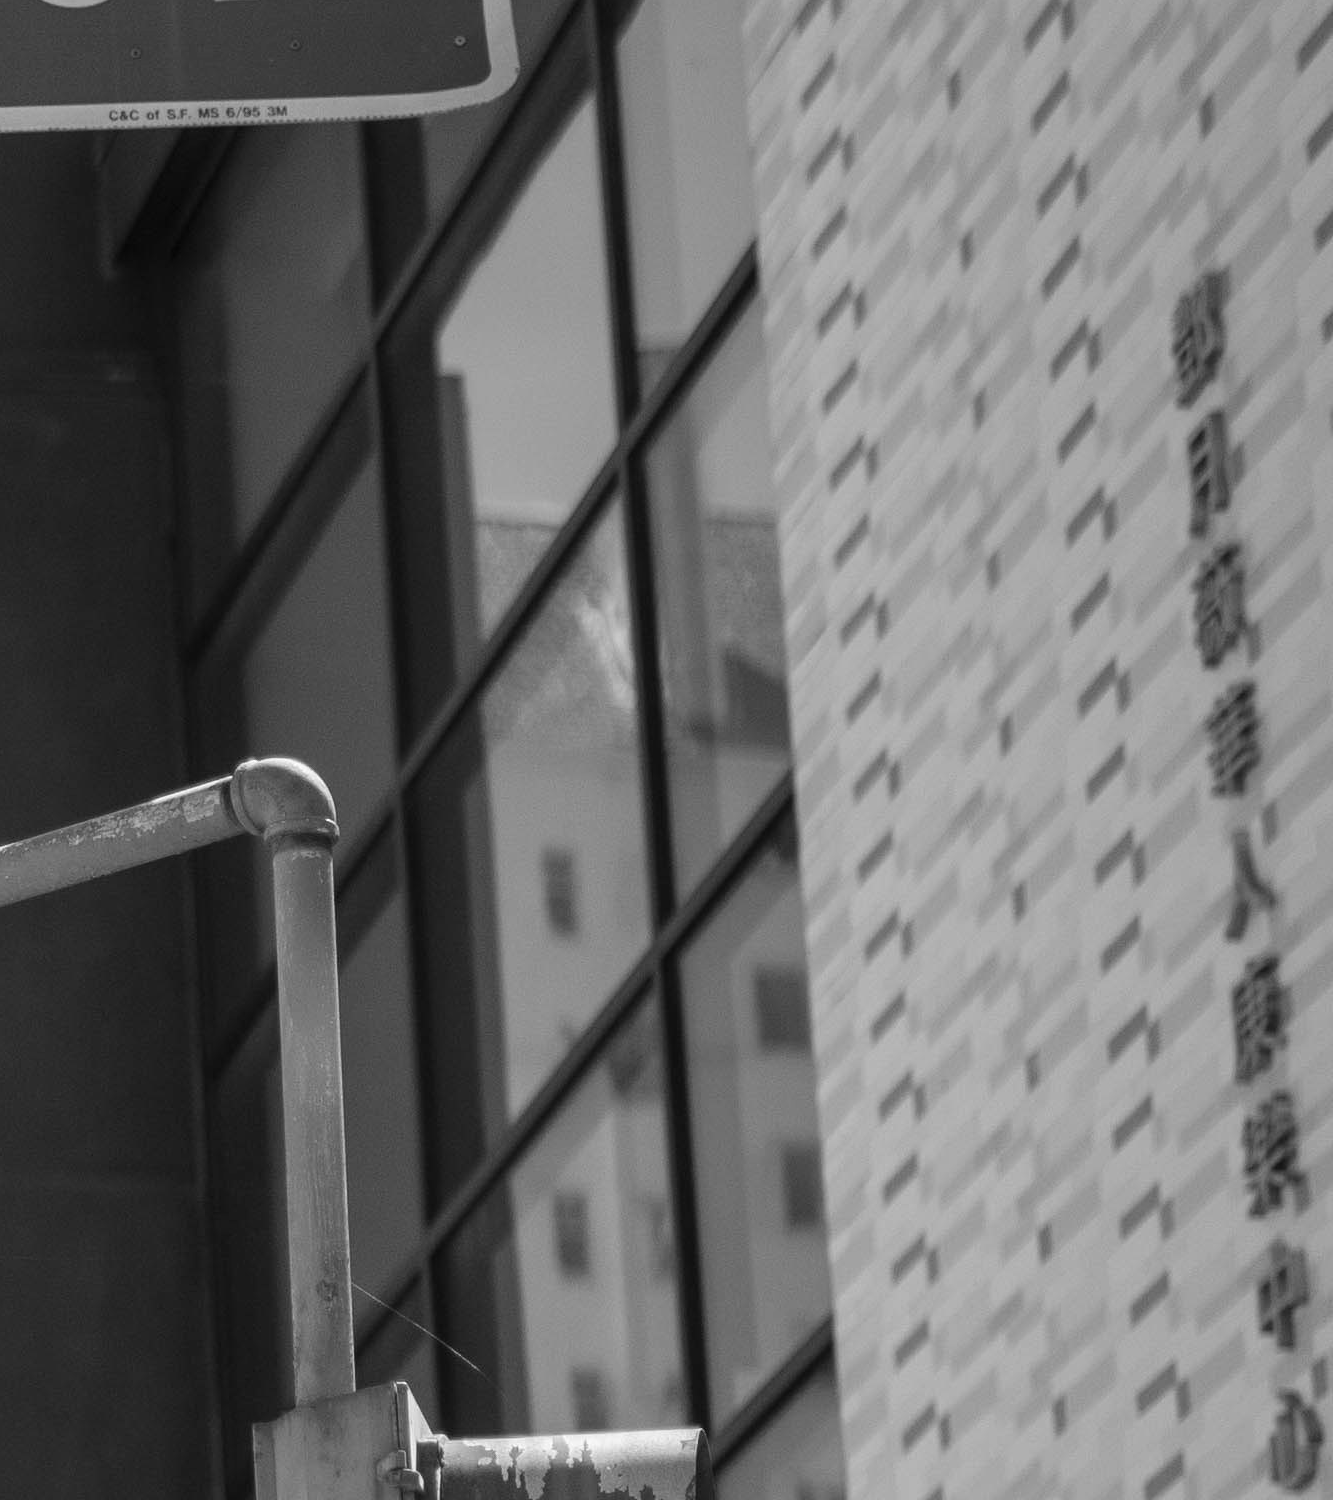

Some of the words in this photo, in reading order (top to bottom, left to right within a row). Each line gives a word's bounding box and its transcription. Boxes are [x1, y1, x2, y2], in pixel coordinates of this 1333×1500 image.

[108, 110, 140, 122] C&C
[146, 109, 160, 121] of
[198, 107, 220, 119] MS
[267, 105, 288, 117] 3M
